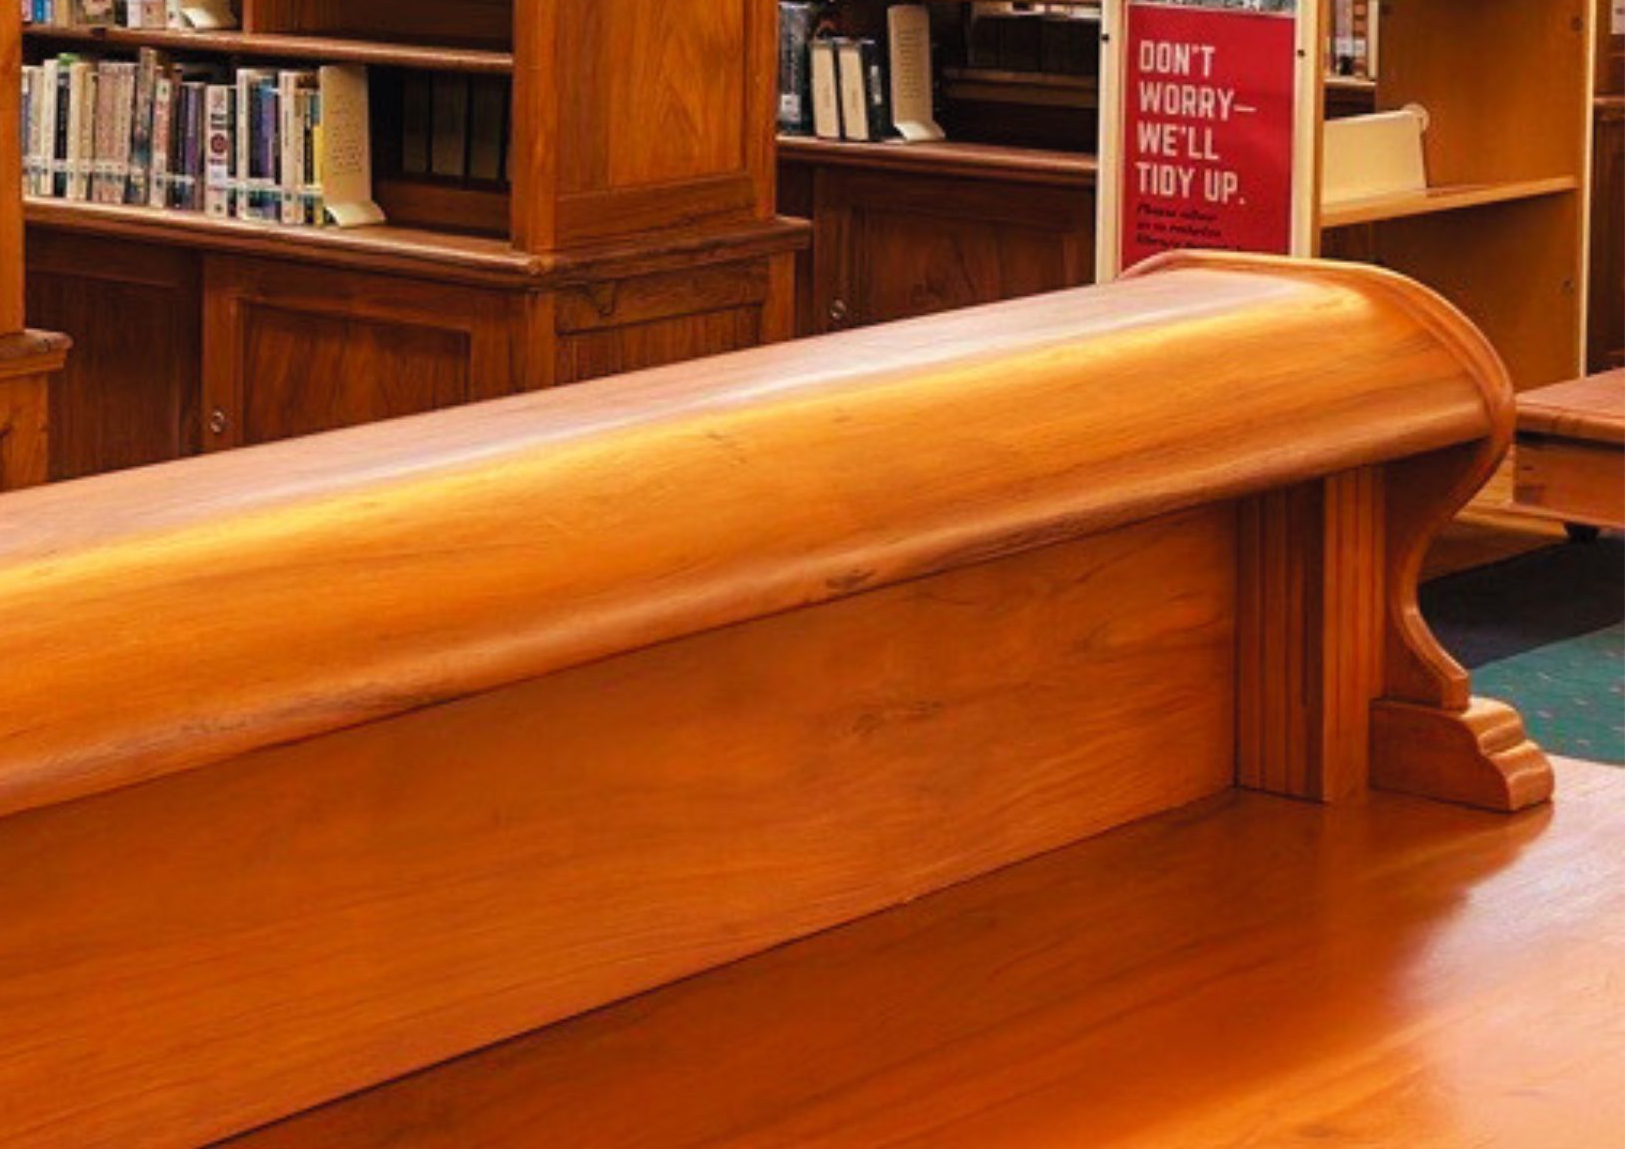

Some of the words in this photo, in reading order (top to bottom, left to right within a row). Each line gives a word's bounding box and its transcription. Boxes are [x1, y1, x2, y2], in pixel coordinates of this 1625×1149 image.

[1140, 39, 1216, 79] DON'T
[1137, 120, 1220, 161] WE'LL
[1134, 161, 1195, 199] TIDY
[1203, 168, 1247, 205] UP.
